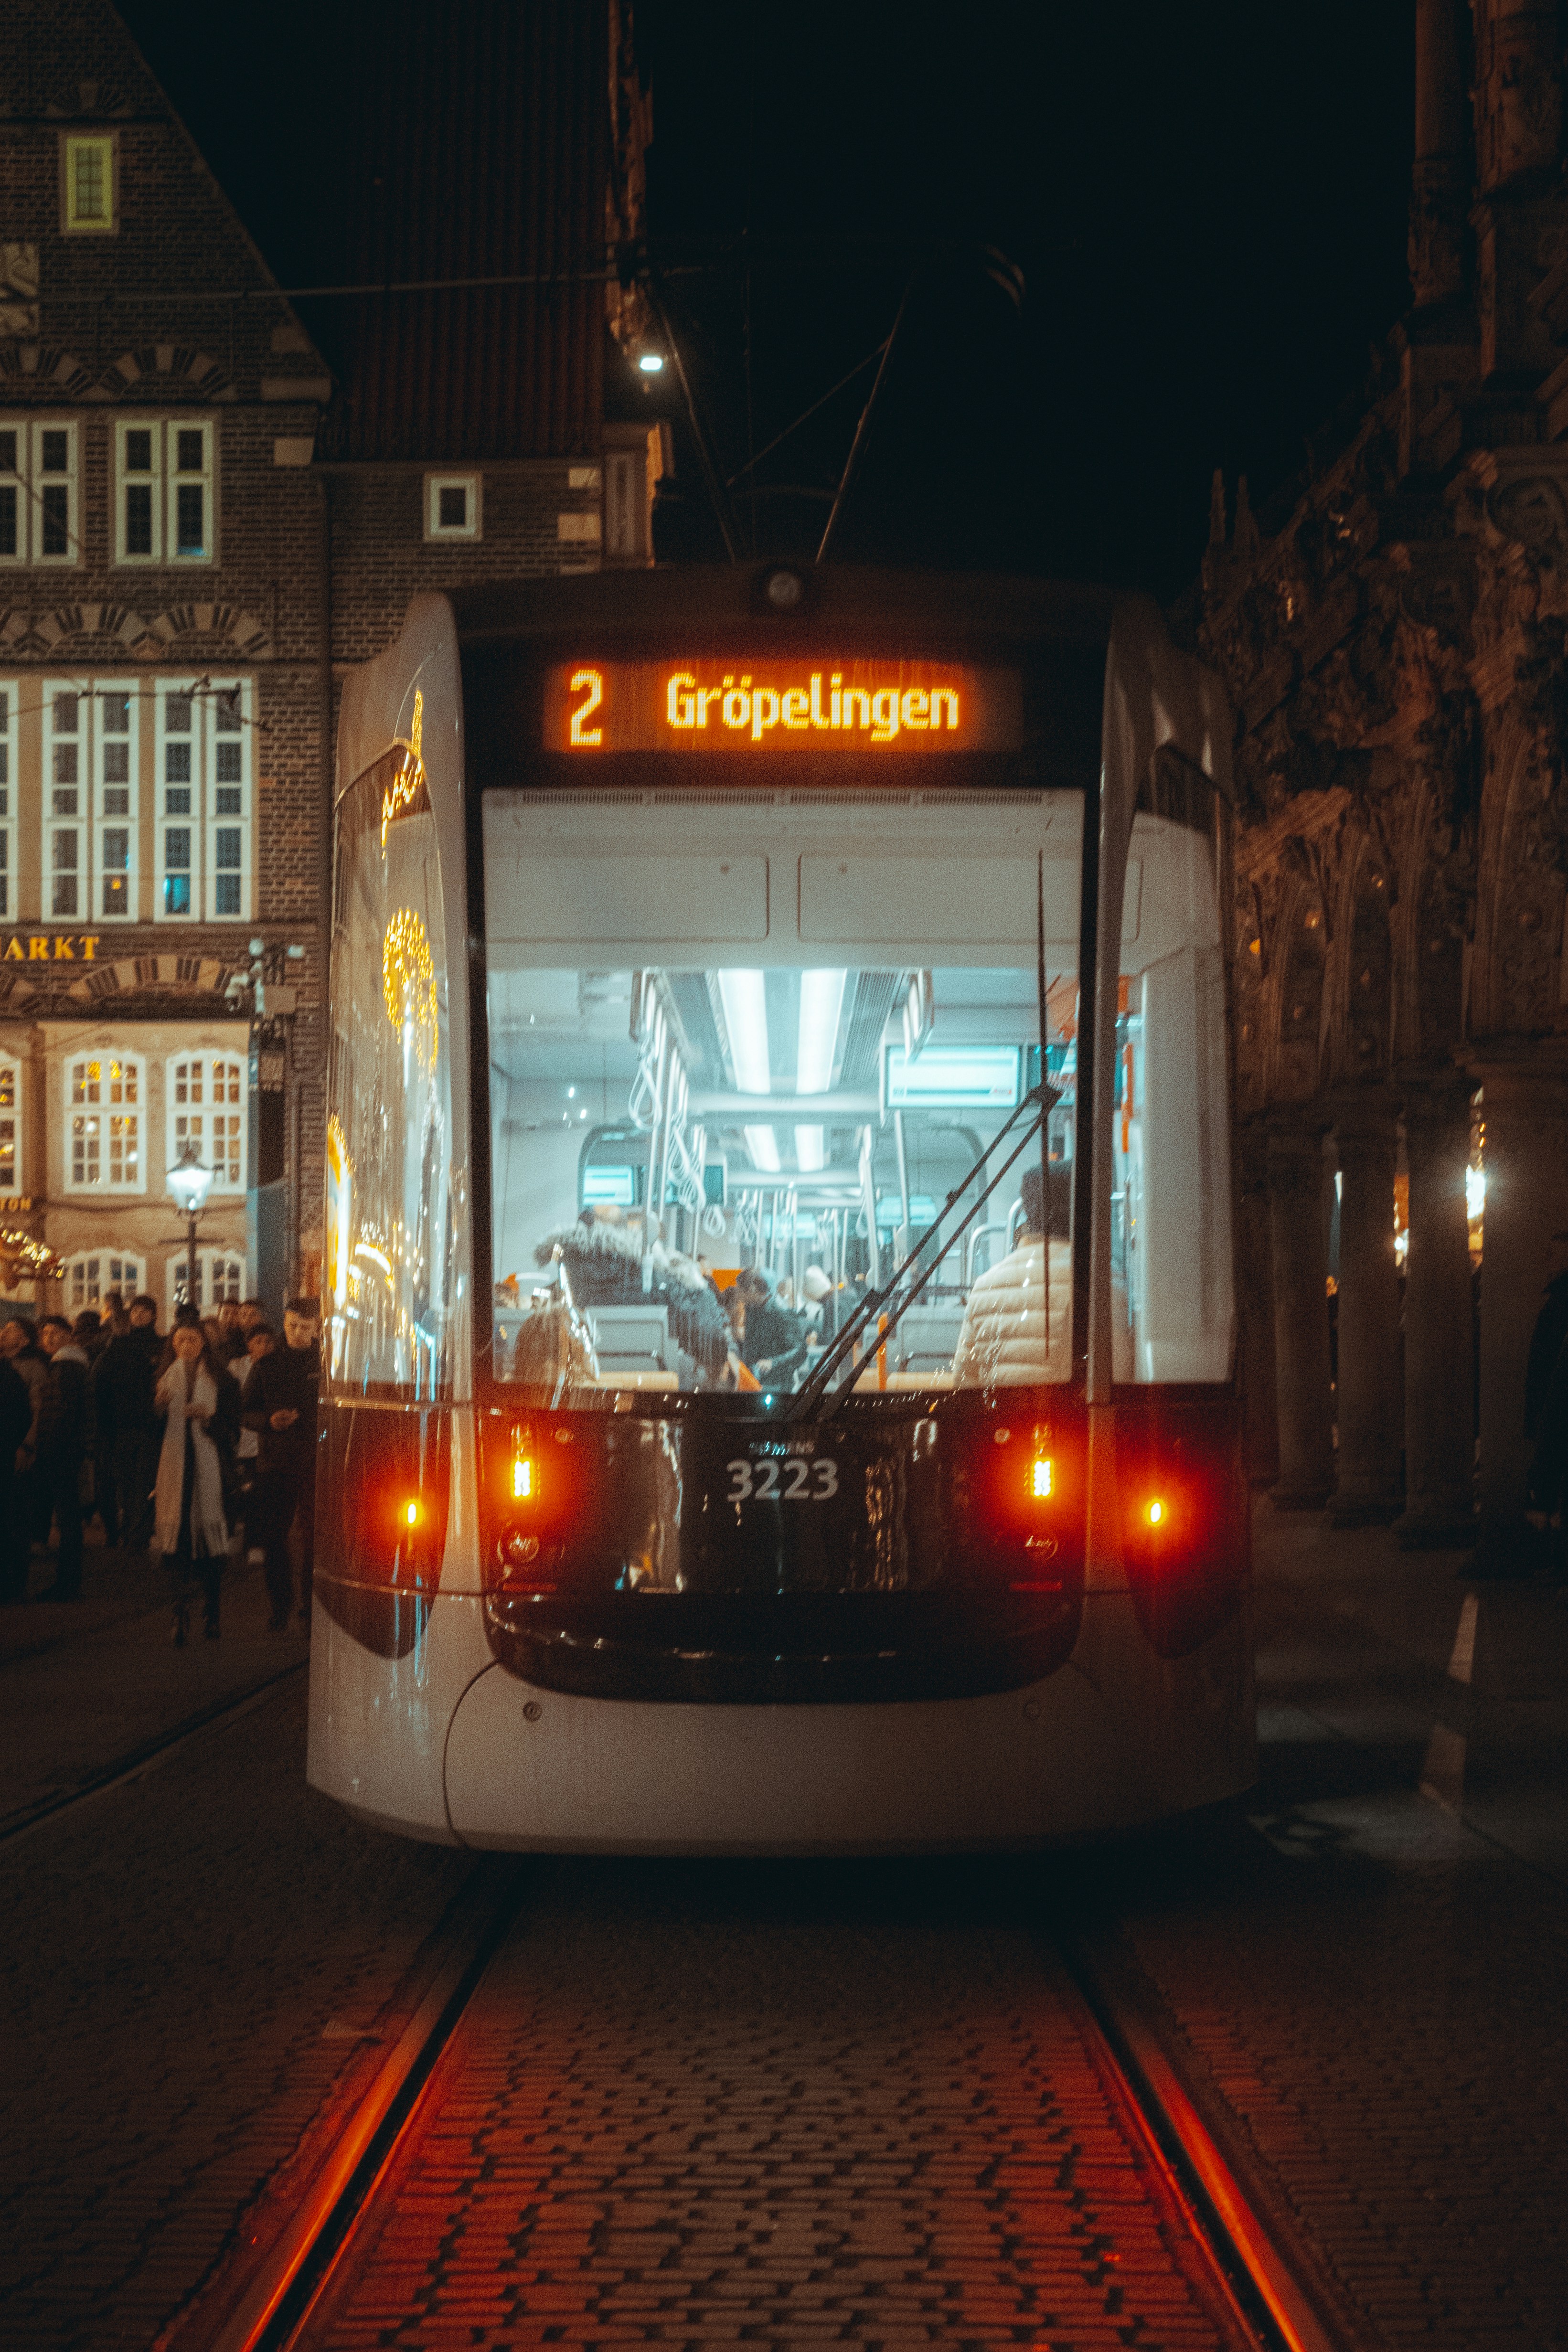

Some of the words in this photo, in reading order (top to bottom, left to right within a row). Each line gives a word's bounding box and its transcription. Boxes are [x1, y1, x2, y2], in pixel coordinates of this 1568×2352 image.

[571, 670, 602, 745] 2
[667, 672, 959, 741] Gröpelingen
[0, 937, 100, 960] ARKT
[726, 1458, 838, 1501] 3223
